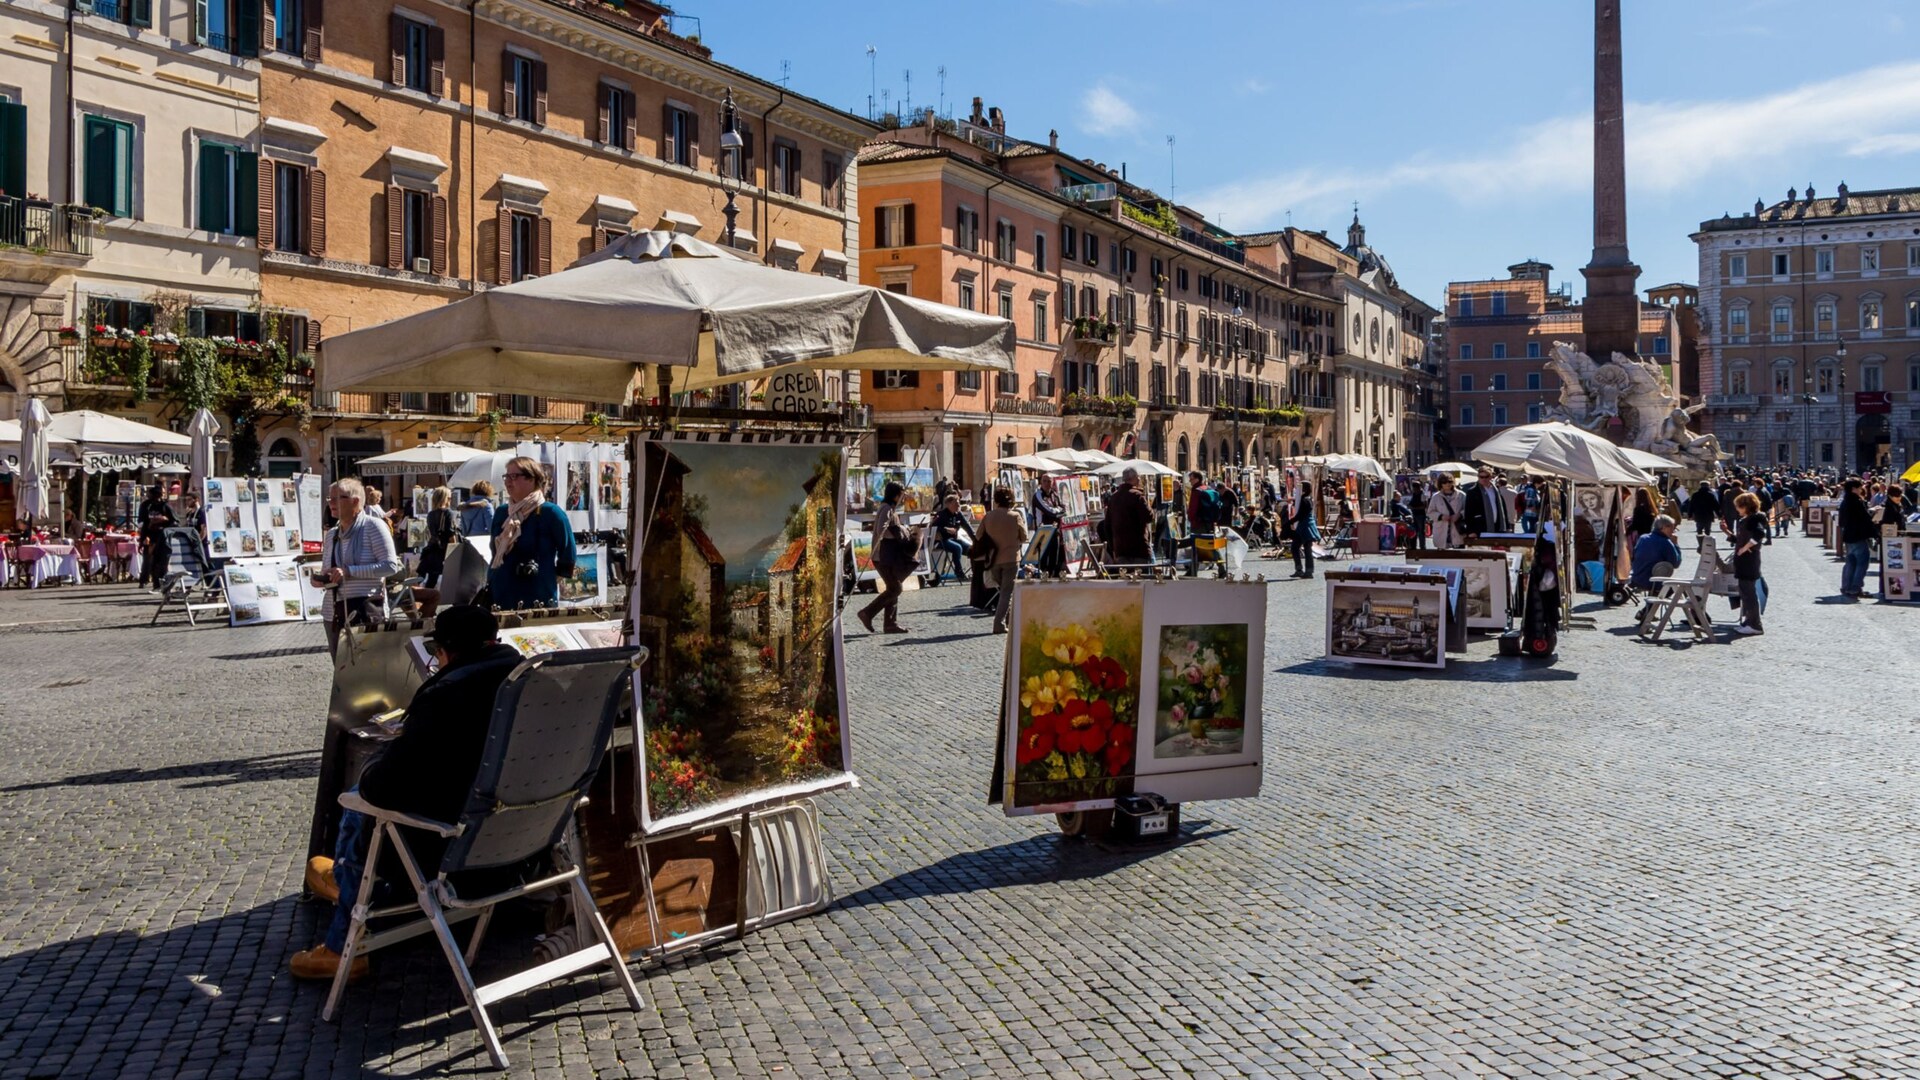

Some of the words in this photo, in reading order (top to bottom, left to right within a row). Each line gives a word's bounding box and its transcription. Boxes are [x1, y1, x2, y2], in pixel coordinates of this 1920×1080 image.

[772, 395, 817, 413] CARD
[91, 453, 137, 469] ROMAN
[142, 451, 190, 467] SPECIALI
[366, 465, 395, 475] COCKTAIL
[427, 464, 439, 473] BAR
